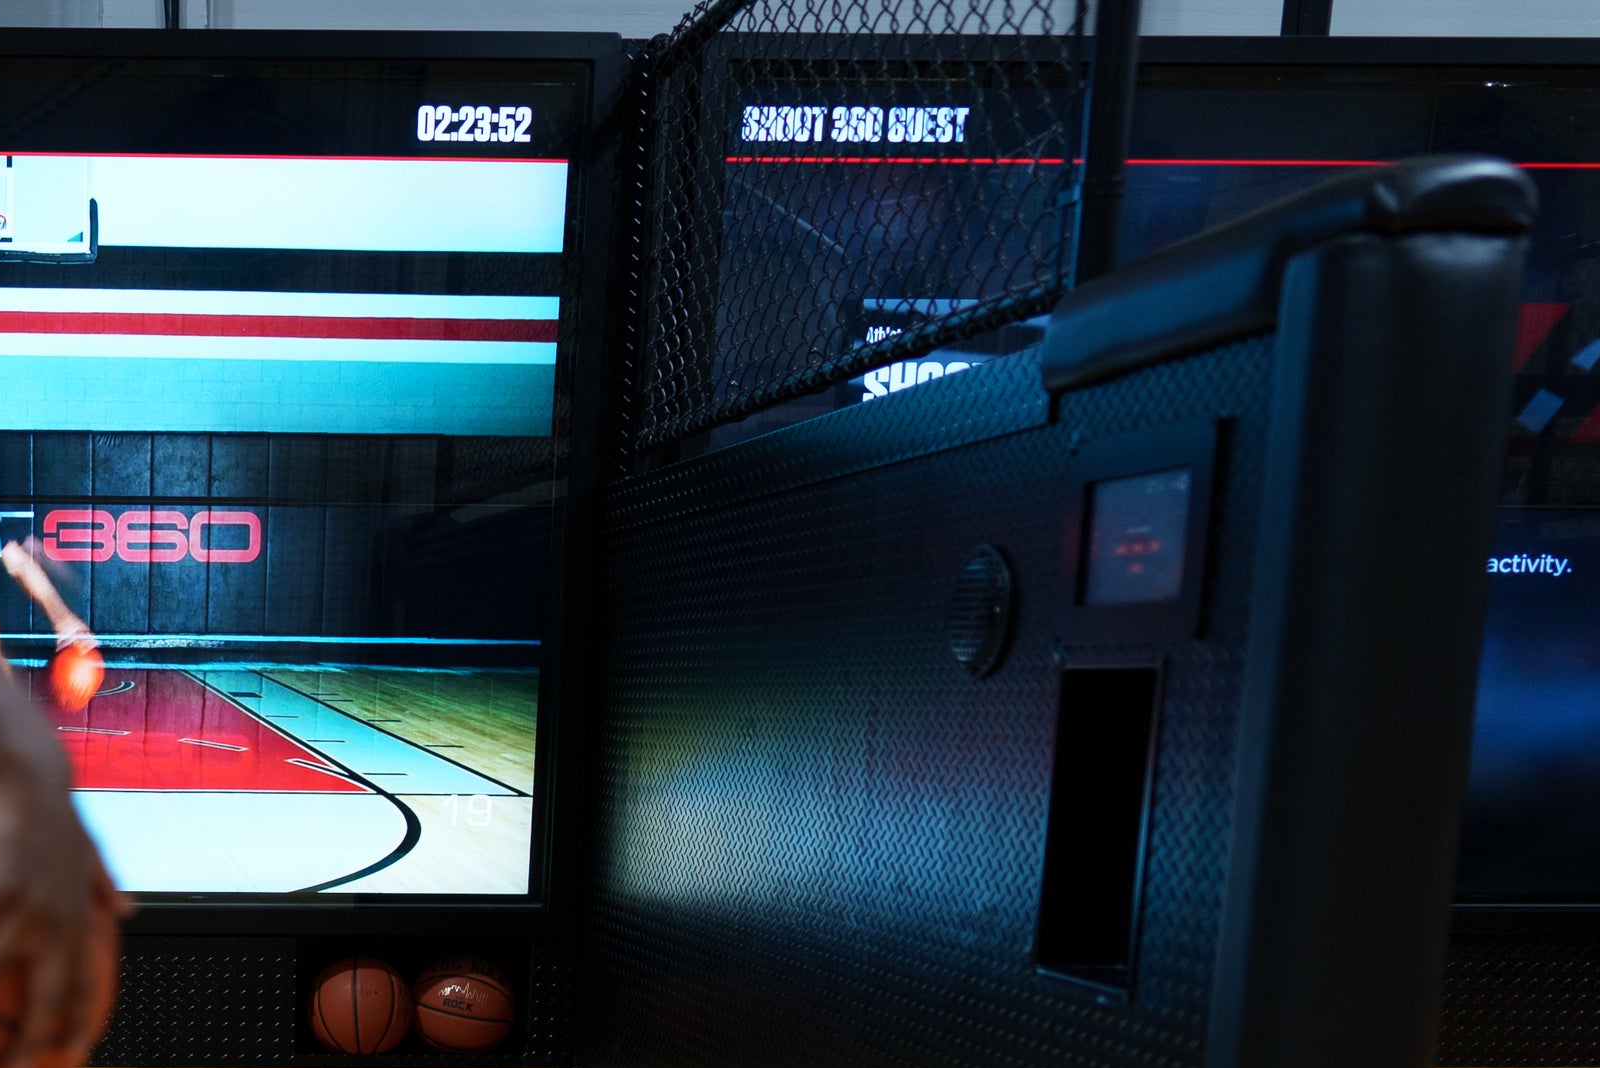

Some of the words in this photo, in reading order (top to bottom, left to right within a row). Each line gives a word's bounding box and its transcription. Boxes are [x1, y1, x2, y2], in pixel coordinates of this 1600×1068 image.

[417, 105, 532, 142] 02:23:52
[741, 106, 828, 142] SHOOT
[831, 106, 884, 142] 360
[887, 107, 970, 143] GUEST
[43, 509, 262, 563] 360
[1486, 554, 1572, 577] activity.
[443, 793, 492, 826] 19
[442, 998, 474, 1012] ROCK
